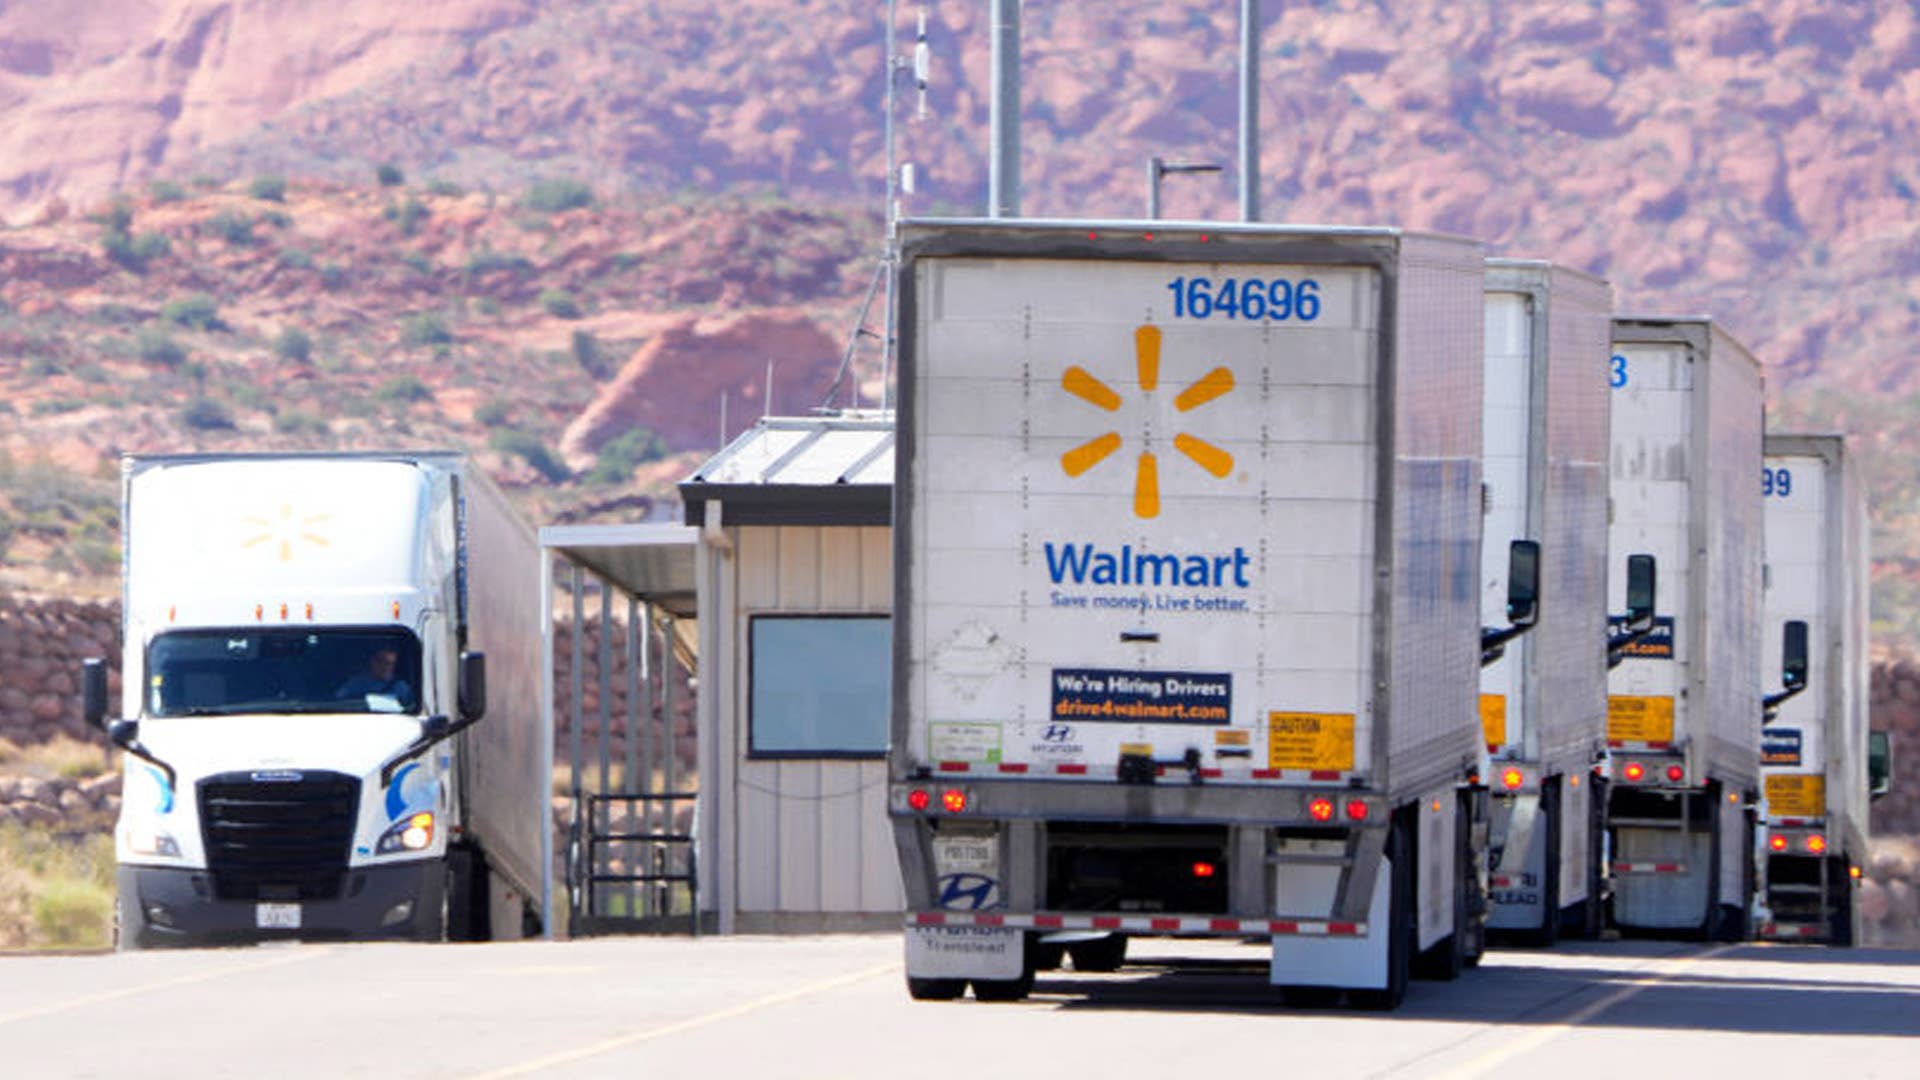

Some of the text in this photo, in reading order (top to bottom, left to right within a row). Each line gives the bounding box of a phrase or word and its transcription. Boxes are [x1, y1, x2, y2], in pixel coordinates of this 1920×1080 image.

[1168, 276, 1320, 321] 164696
[1044, 541, 1250, 588] Walmart
[1051, 592, 1250, 615] Save money. Live better.
[1057, 675, 1226, 698] We're Hiring Drivers
[1056, 699, 1227, 719] drive4walmart.com
